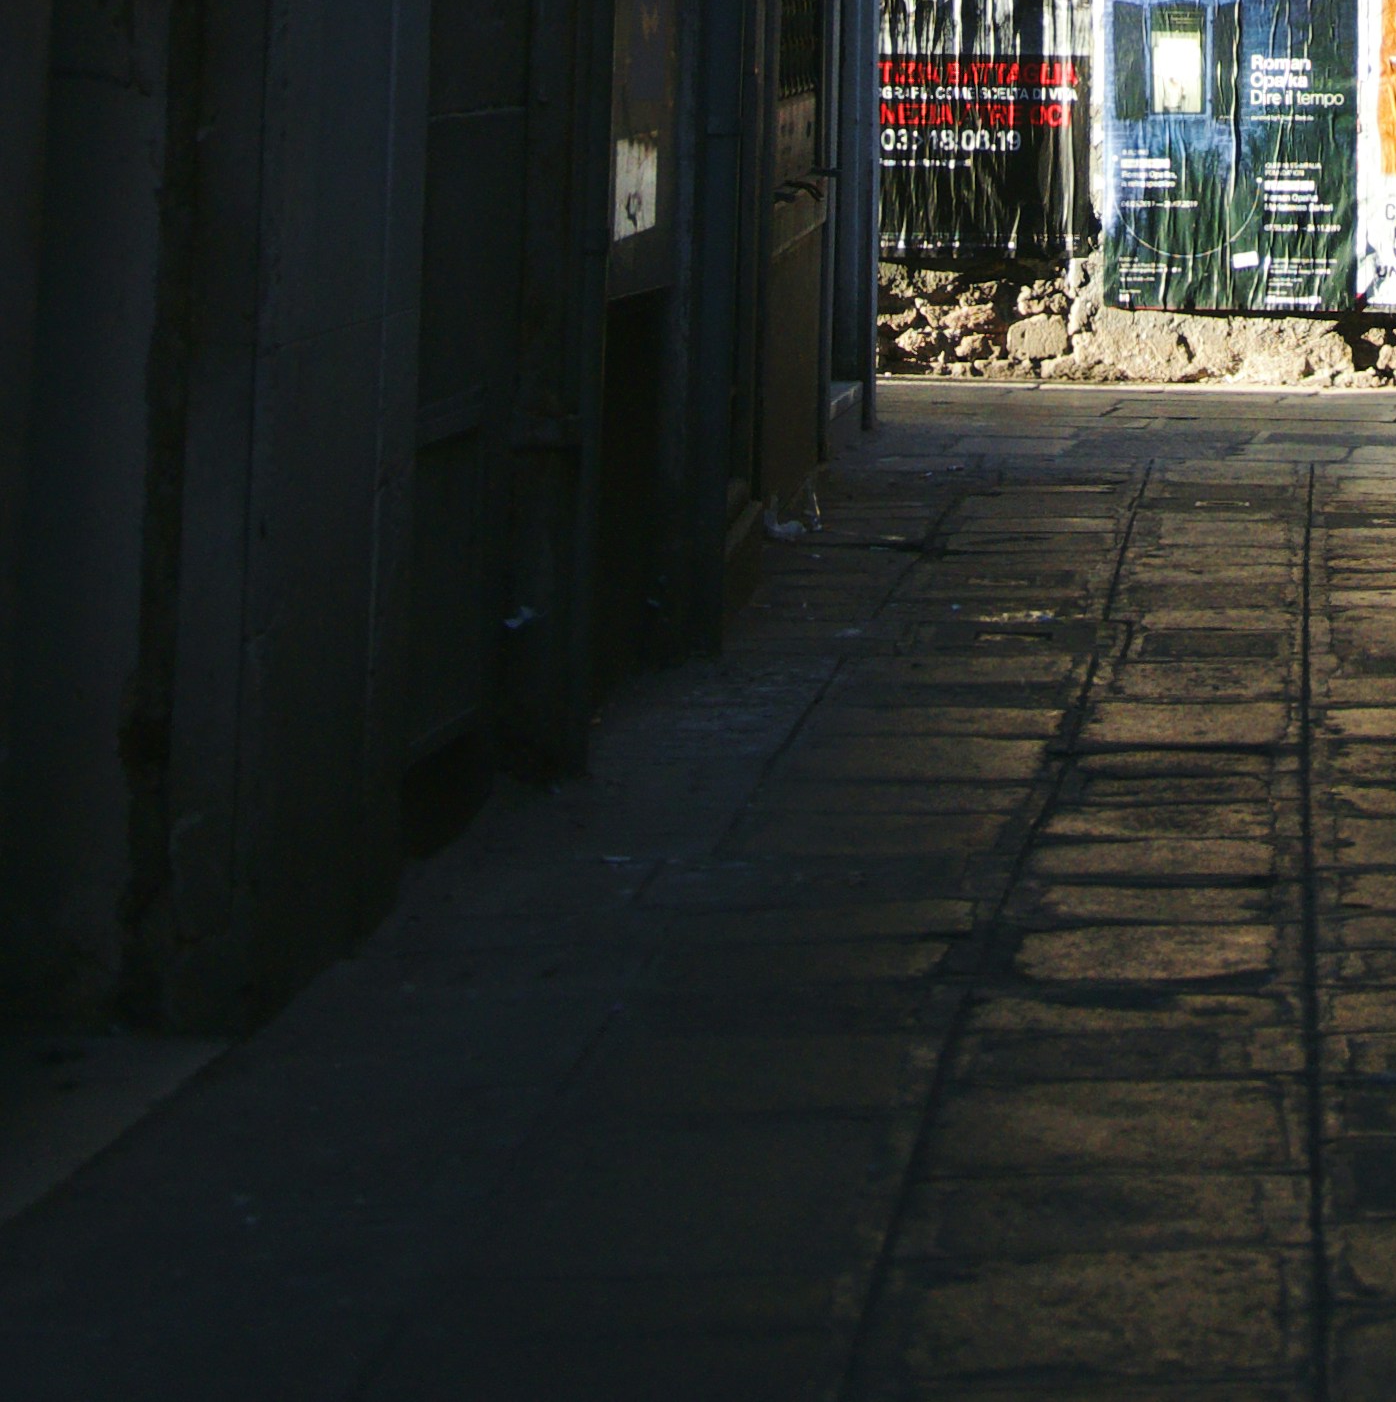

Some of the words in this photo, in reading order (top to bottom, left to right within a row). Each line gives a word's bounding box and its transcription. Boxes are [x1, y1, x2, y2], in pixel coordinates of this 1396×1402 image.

[1251, 54, 1312, 71] Roman
[1250, 89, 1283, 106] Dire
[1284, 89, 1294, 106] il
[1296, 90, 1346, 109] tempo
